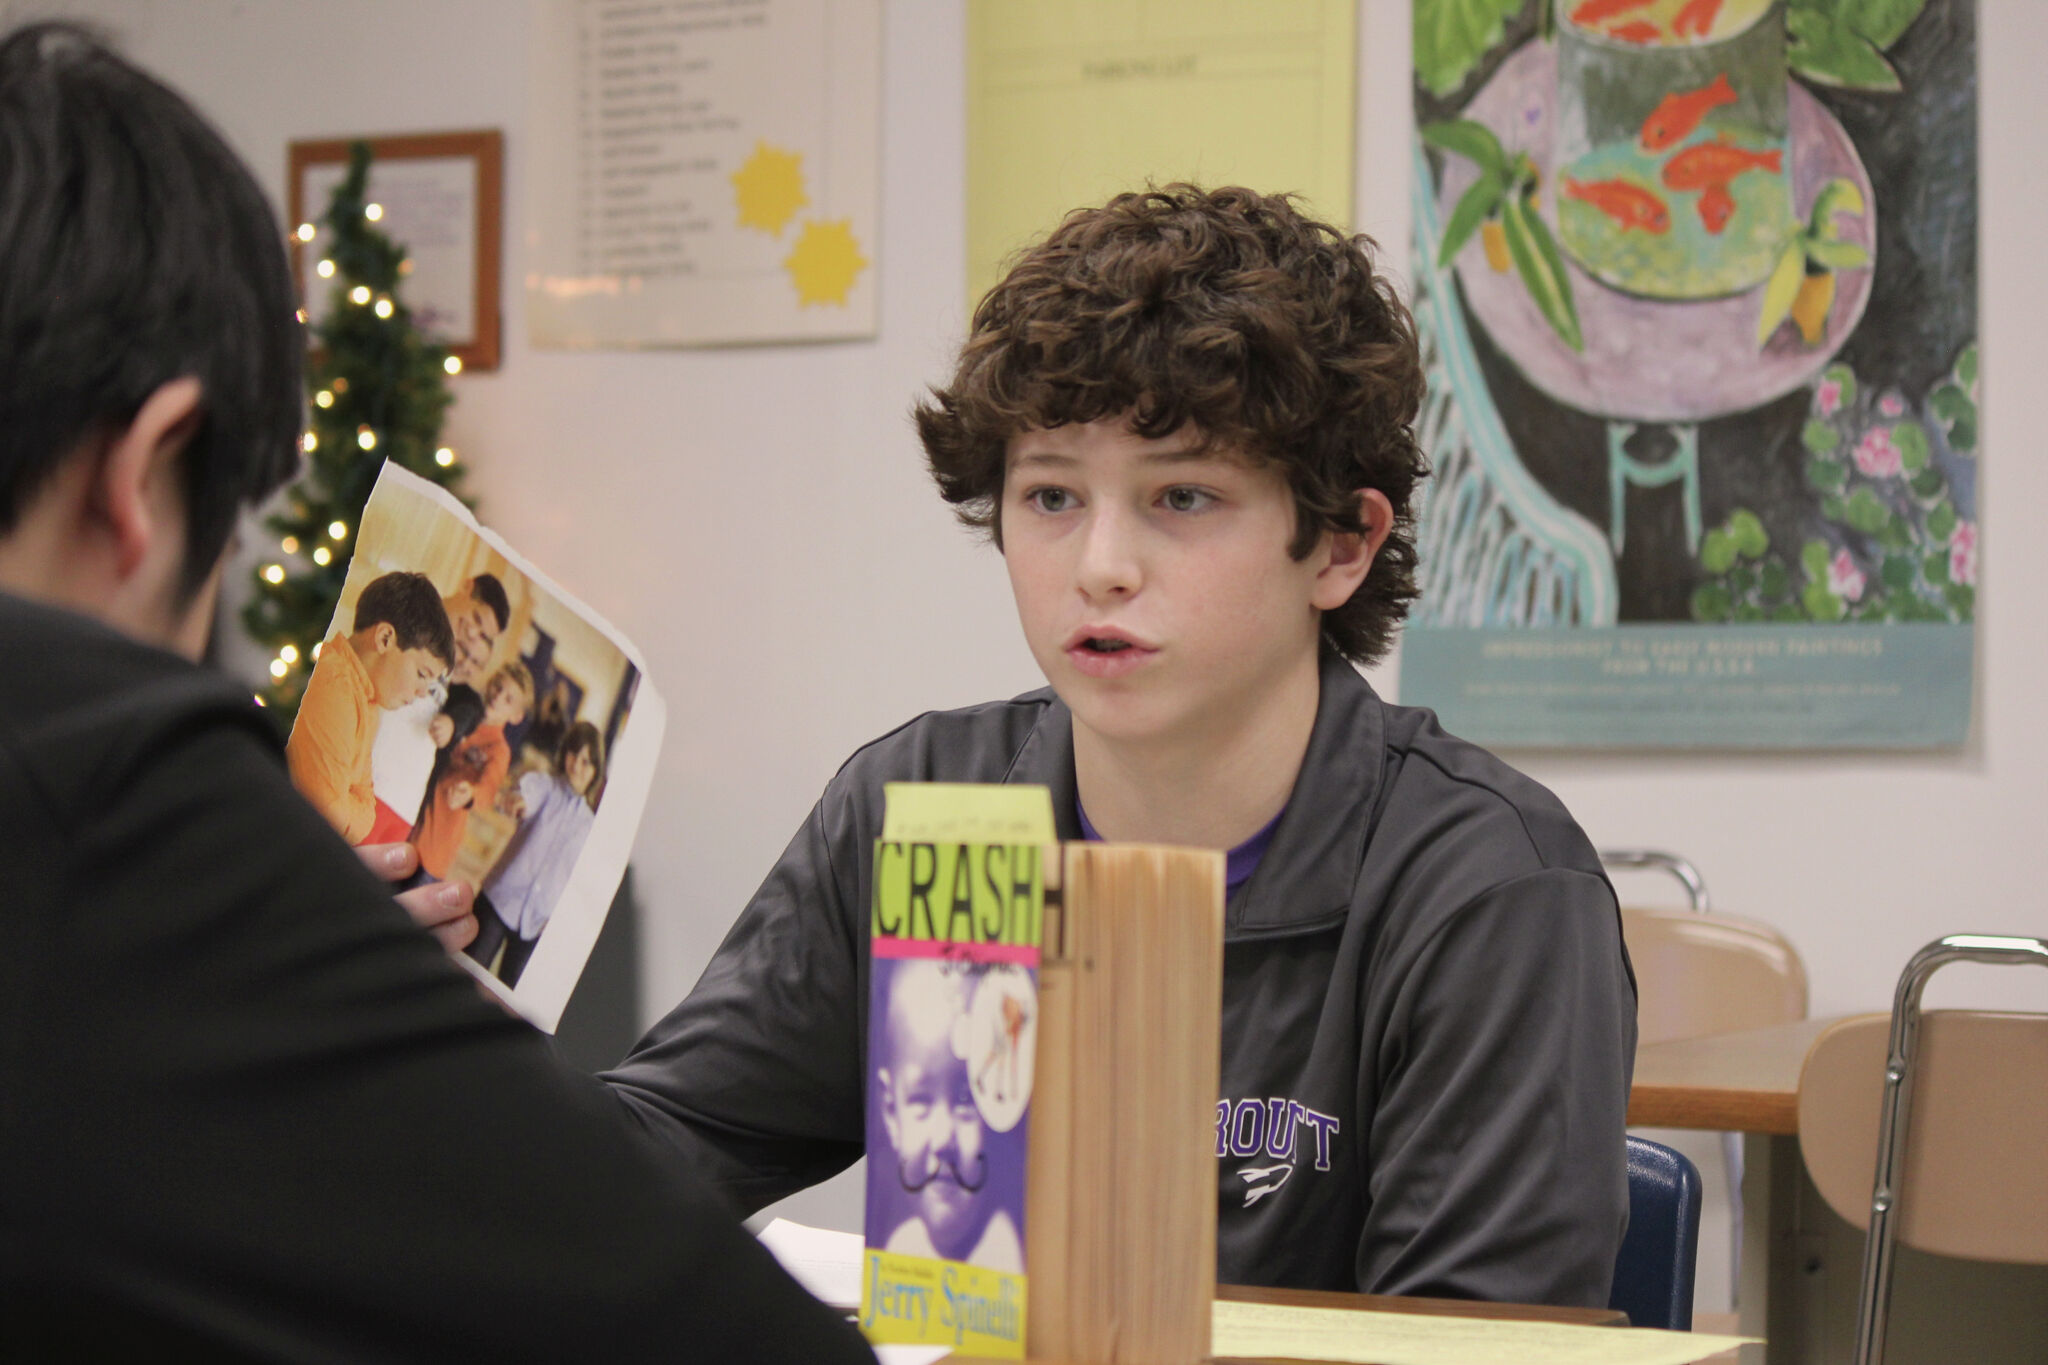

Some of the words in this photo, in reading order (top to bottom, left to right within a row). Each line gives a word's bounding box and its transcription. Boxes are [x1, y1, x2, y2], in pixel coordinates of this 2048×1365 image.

[876, 841, 1037, 945] CRASH
[865, 1255, 934, 1339] Jerry
[940, 1265, 1021, 1346] Spinelli
